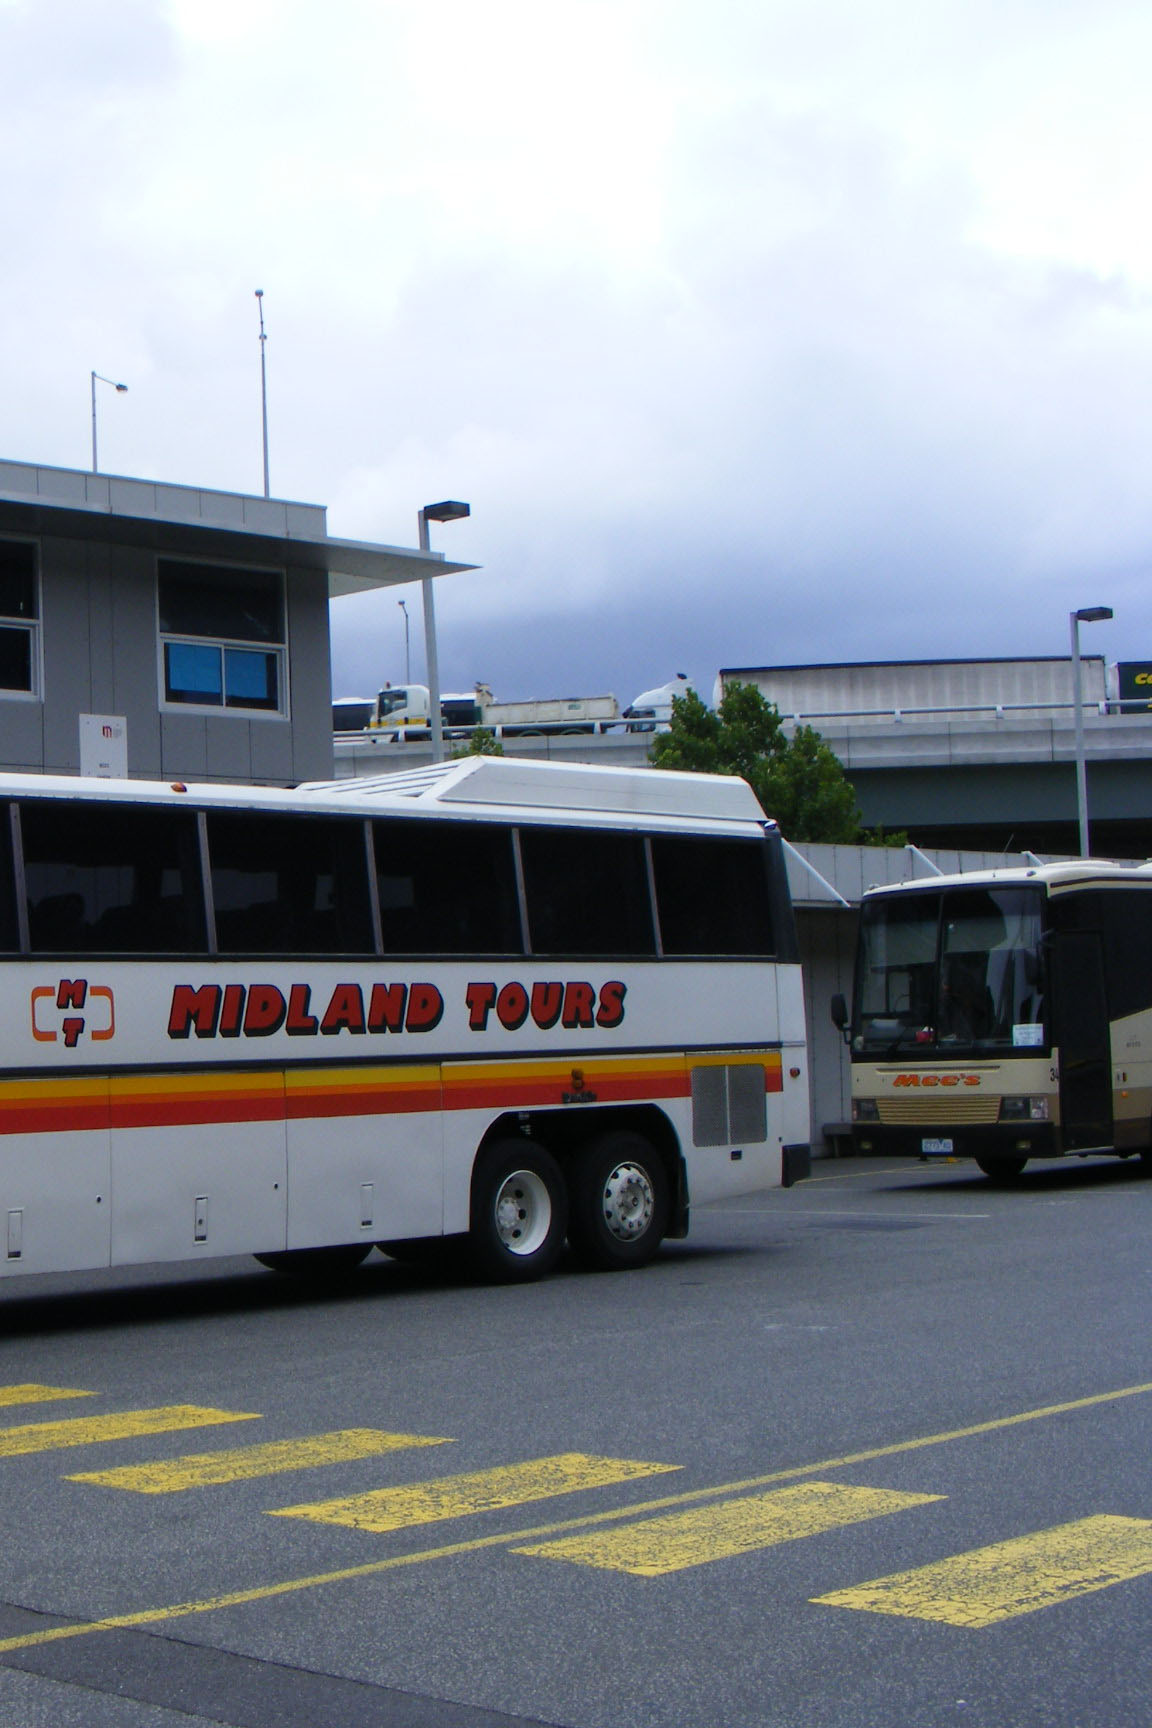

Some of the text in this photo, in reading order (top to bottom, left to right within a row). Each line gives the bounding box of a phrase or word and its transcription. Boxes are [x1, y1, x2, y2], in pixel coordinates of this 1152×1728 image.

[56, 979, 88, 1009] M
[168, 981, 627, 1039] MIDLAND TOURS
[61, 1017, 86, 1048] T
